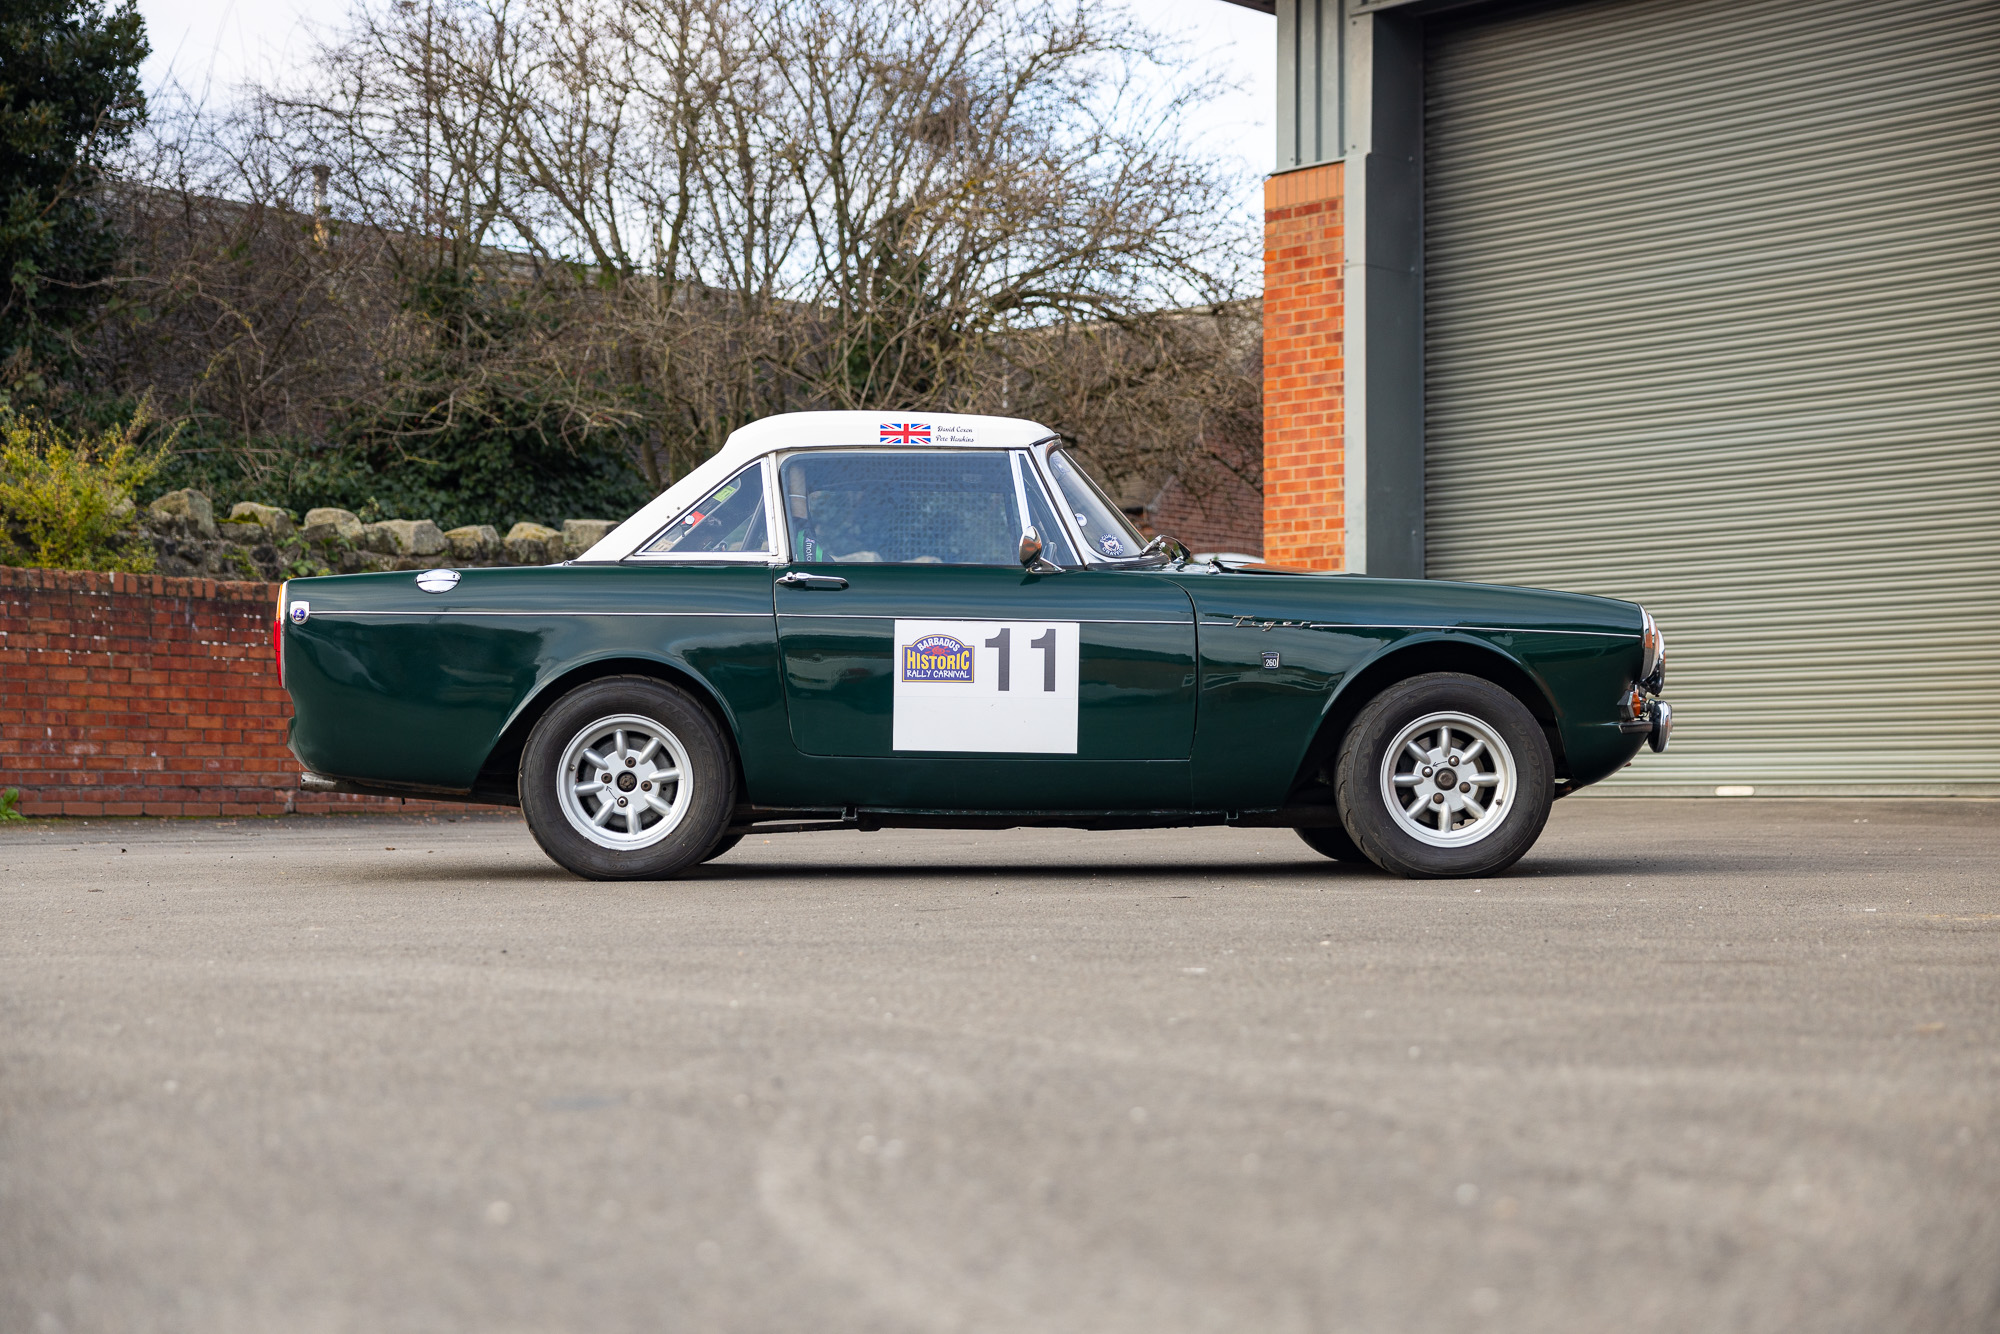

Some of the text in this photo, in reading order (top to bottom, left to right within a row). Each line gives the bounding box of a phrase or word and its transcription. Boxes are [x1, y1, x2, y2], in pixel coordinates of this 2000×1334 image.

[950, 435, 974, 443] Hawkins
[1232, 614, 1311, 632] Tiger
[916, 637, 961, 651] BARBADOS
[906, 648, 970, 670] HISTORIC
[985, 627, 1056, 692] 11
[1265, 658, 1277, 667] 260
[906, 669, 970, 679] RALLY CARNIVAL
